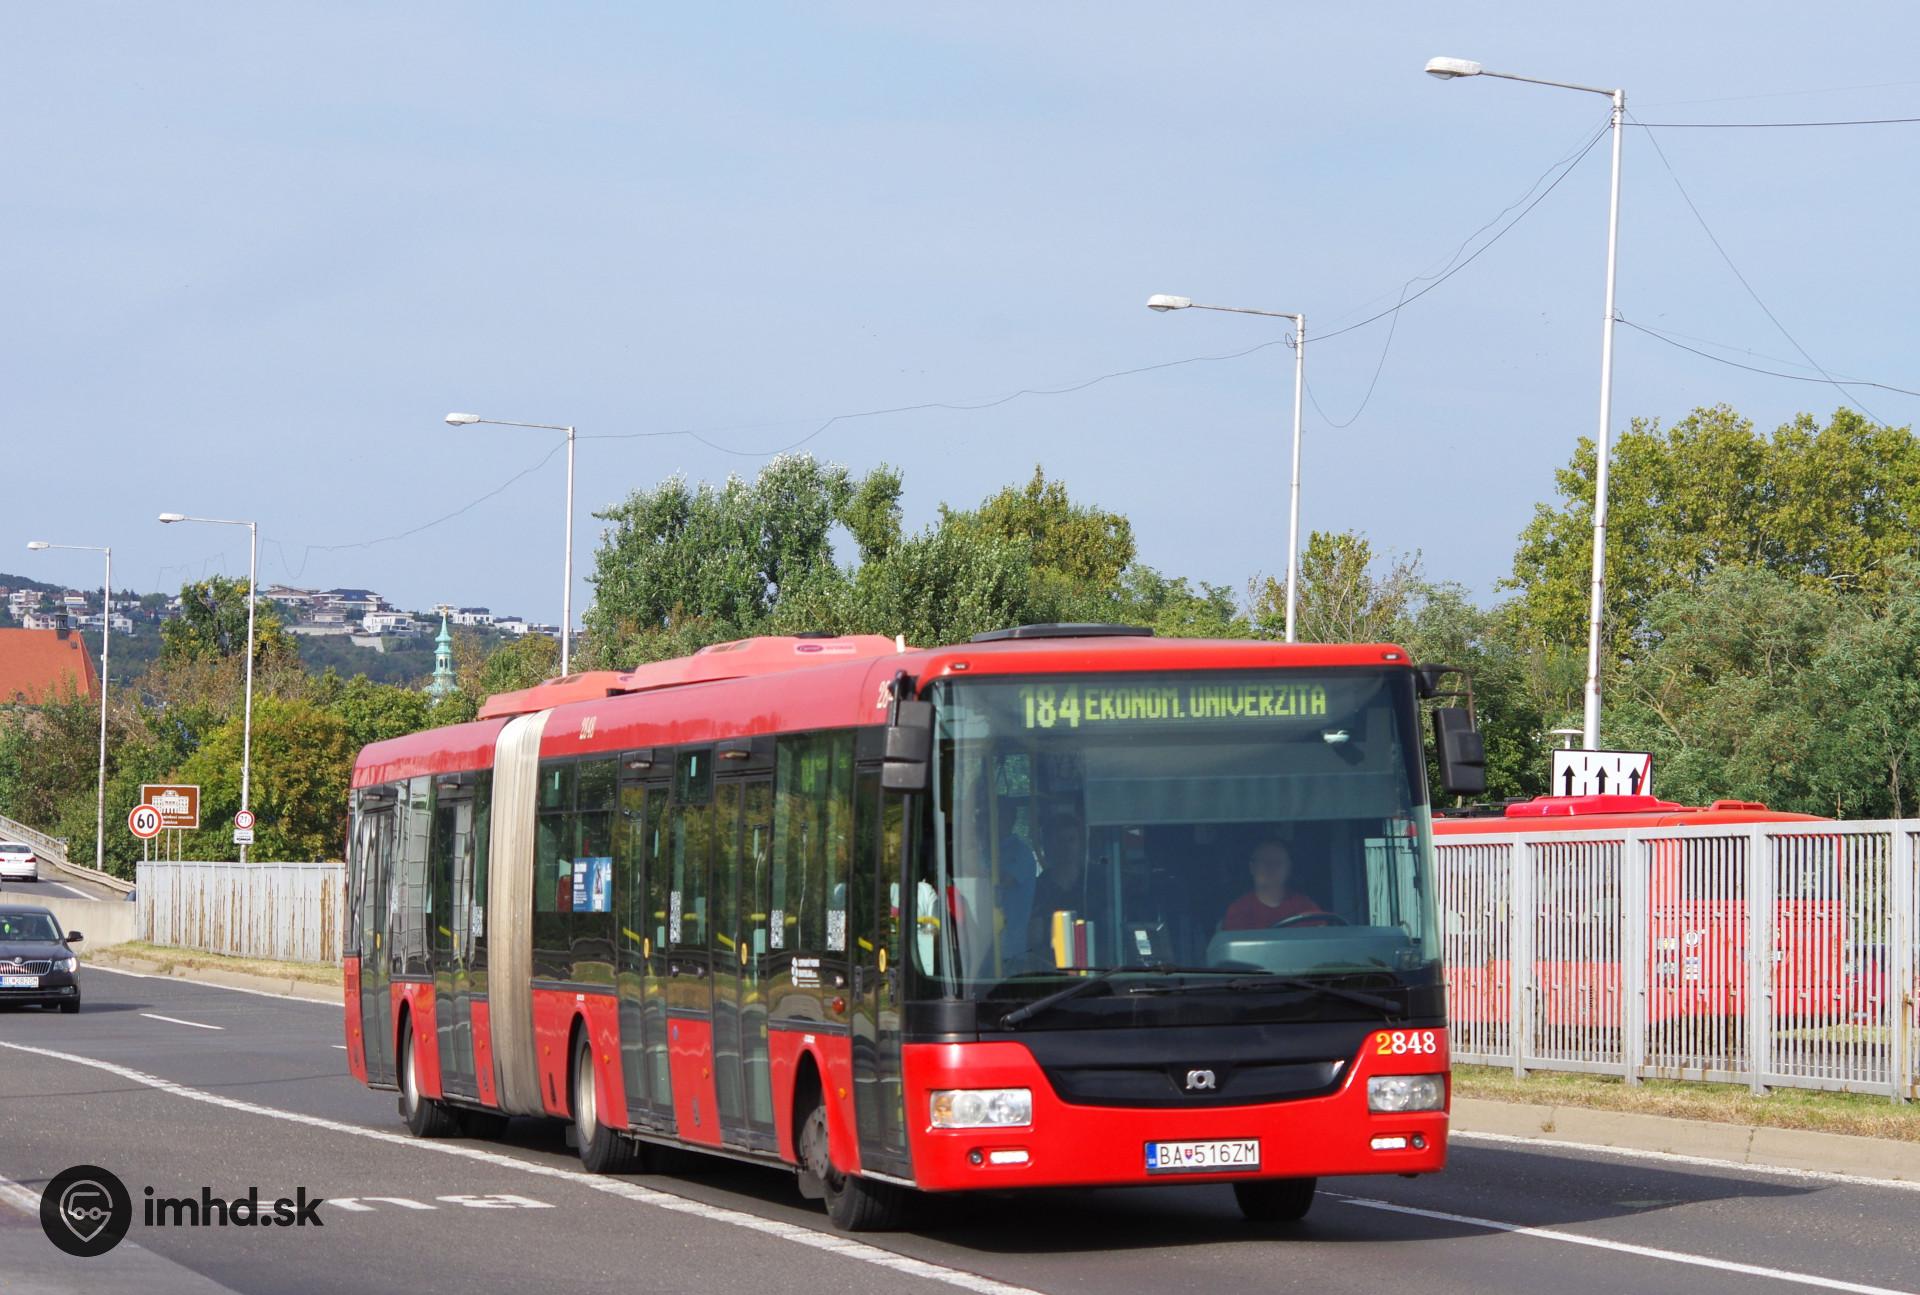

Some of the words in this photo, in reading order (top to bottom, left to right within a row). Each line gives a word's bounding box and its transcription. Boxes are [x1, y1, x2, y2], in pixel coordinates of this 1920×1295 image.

[1019, 684, 1080, 728] 184
[1085, 688, 1185, 720] EKONOM.
[1190, 685, 1326, 717] UNIVERZITA
[137, 813, 155, 829] 60
[1376, 1031, 1436, 1055] 2848
